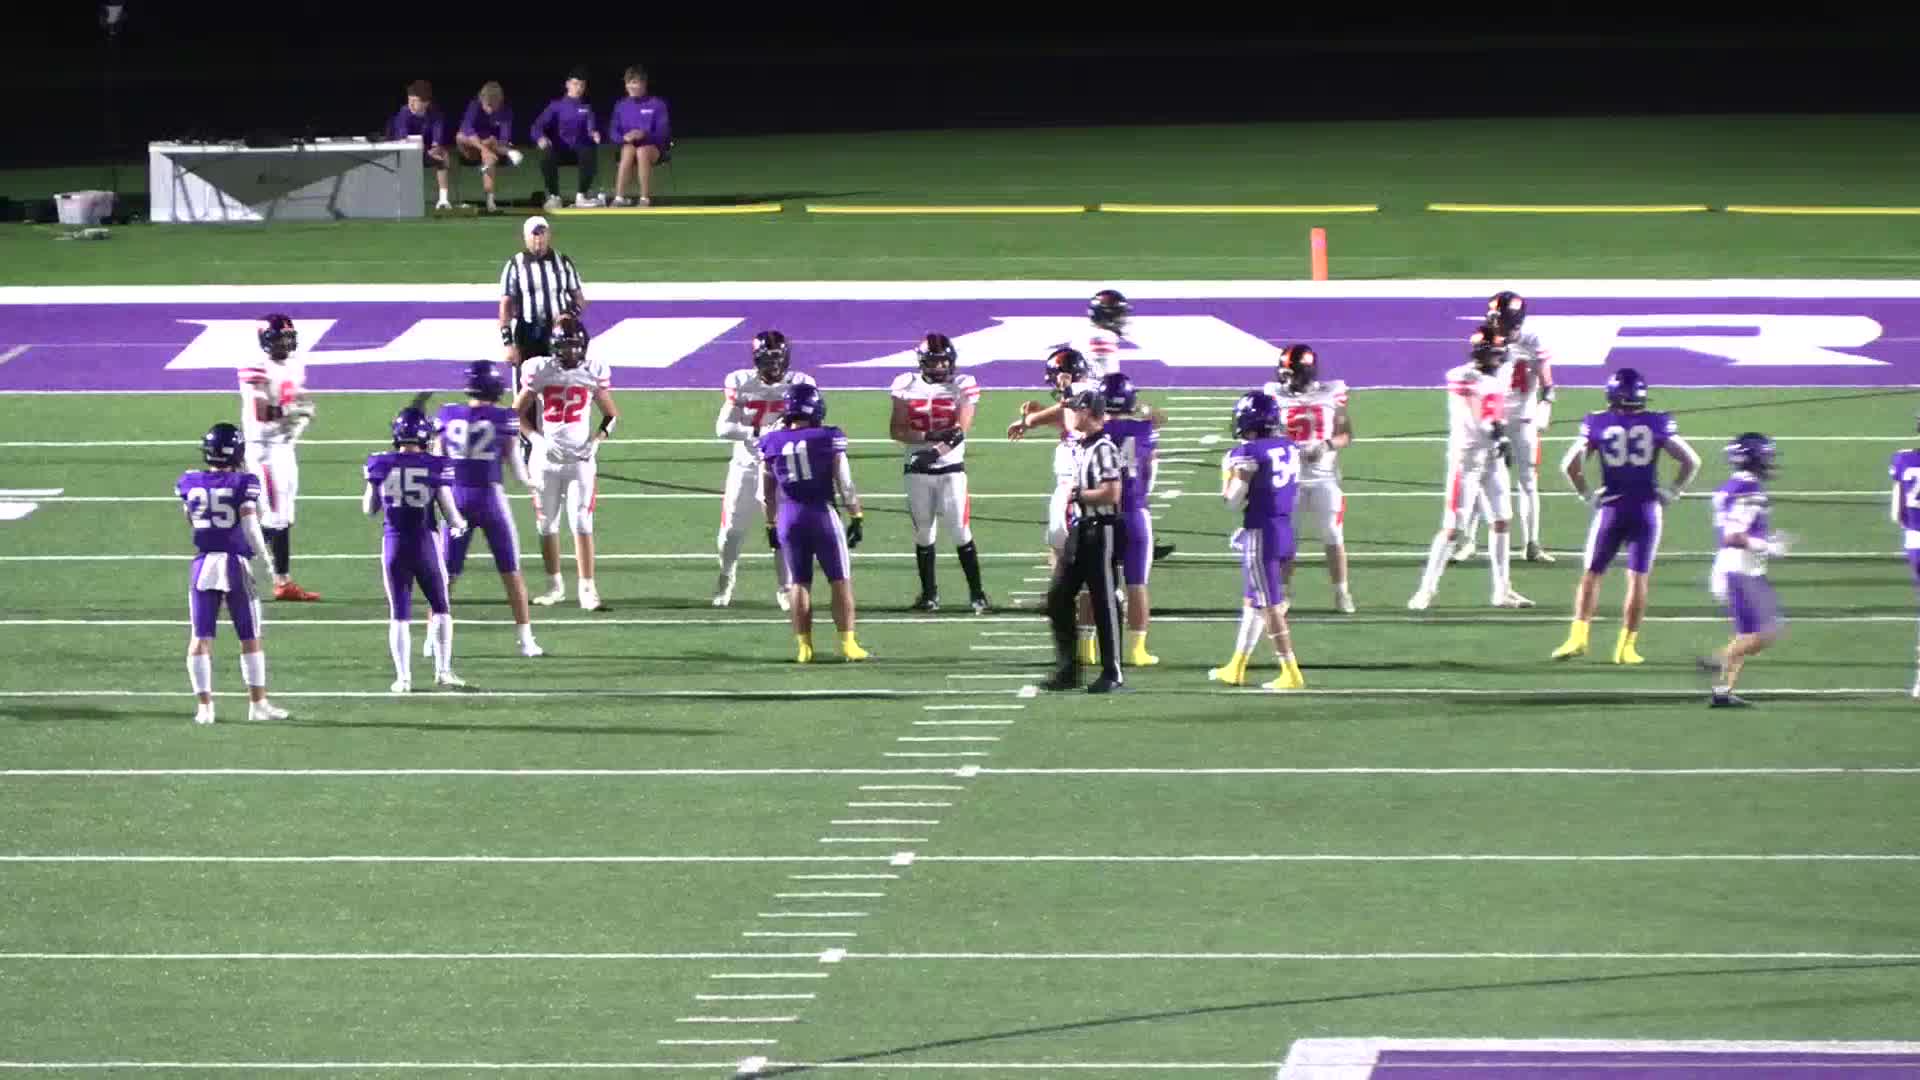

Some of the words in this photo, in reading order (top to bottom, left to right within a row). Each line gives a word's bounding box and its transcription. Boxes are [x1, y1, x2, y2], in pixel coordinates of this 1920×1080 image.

[542, 385, 588, 424] 52
[908, 397, 956, 431] 55
[1286, 405, 1325, 442] 51
[445, 418, 496, 460] 92
[1602, 425, 1654, 466] 33
[781, 440, 812, 482] 11
[186, 487, 236, 528] 25
[382, 467, 430, 508] 45
